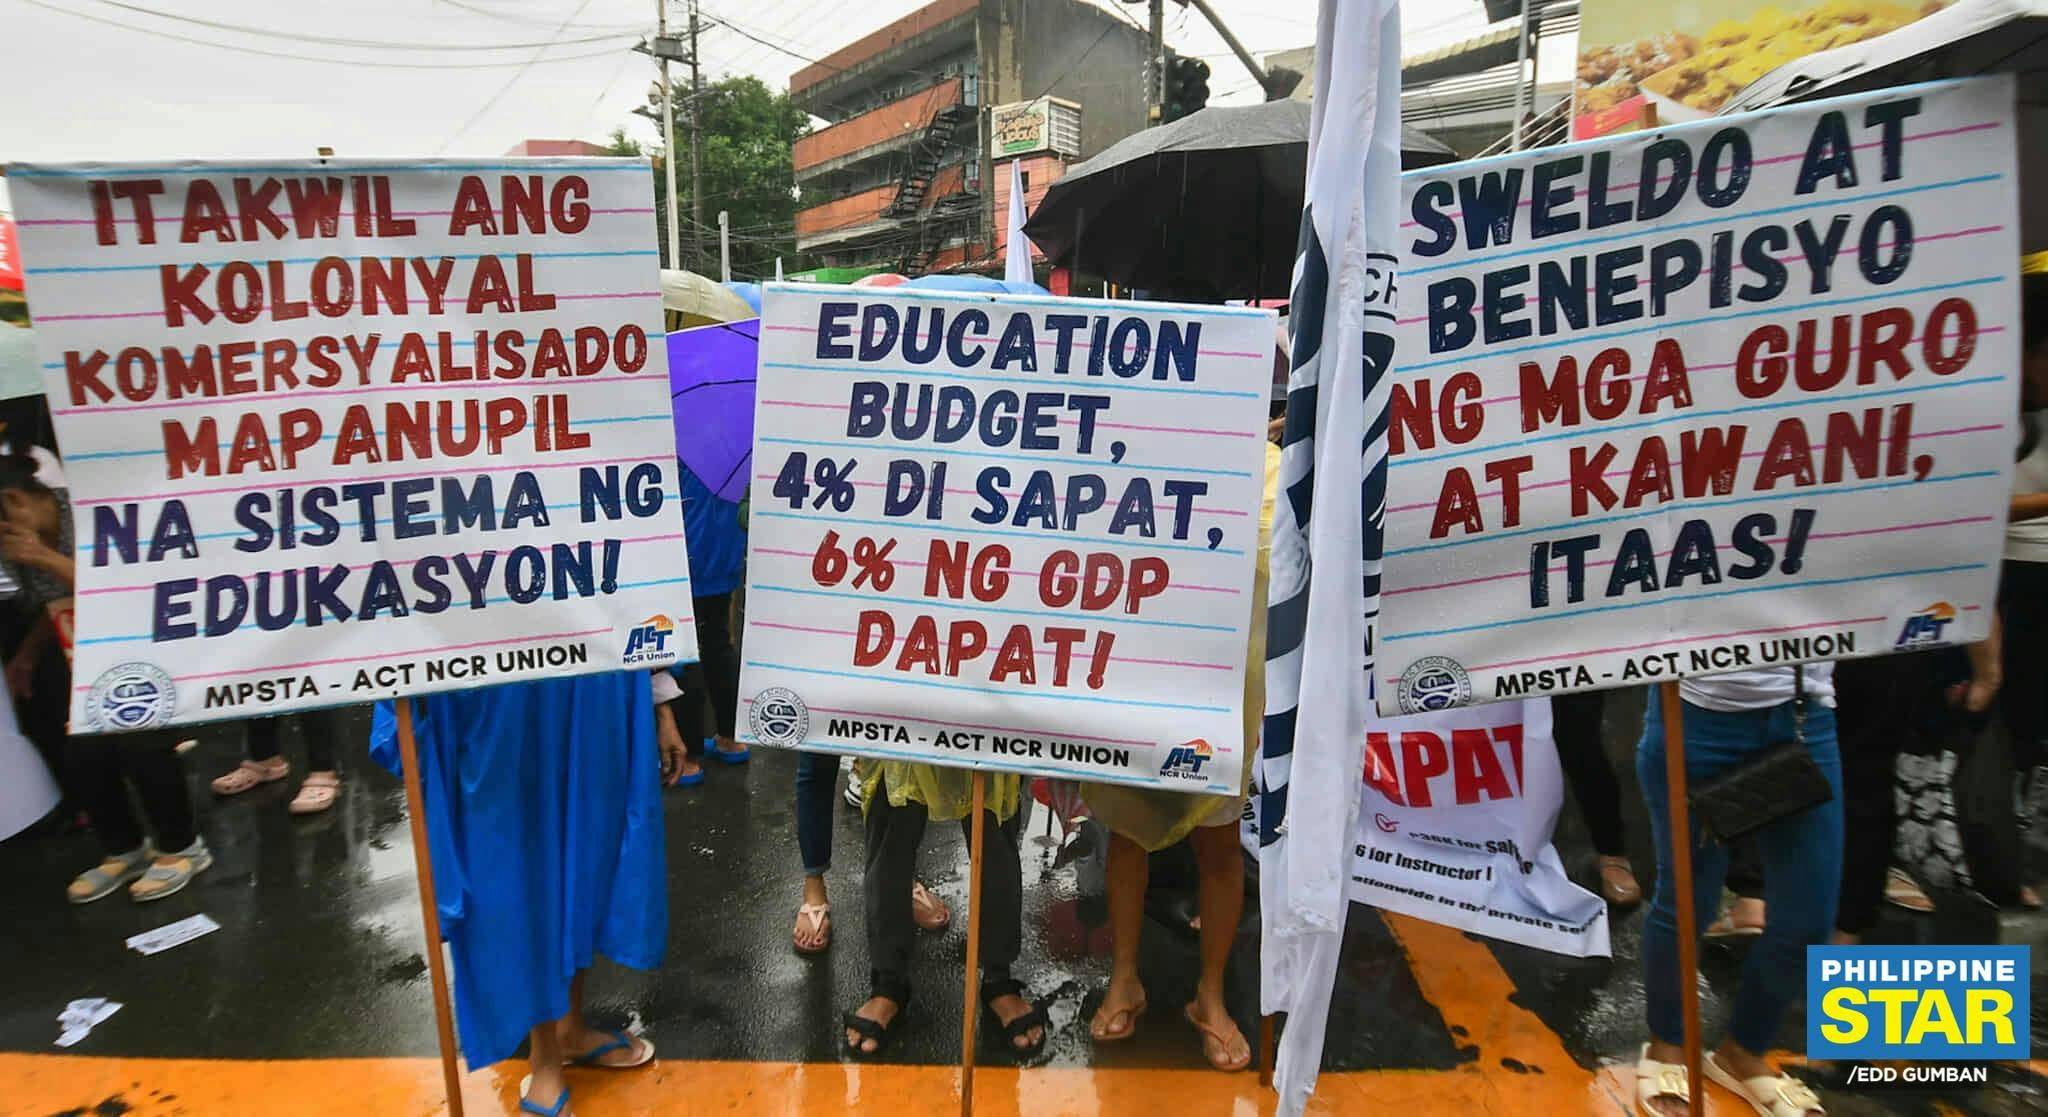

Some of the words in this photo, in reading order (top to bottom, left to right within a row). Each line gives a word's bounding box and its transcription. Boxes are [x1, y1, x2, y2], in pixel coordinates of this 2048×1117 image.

[88, 176, 417, 246] ITAKWIL
[448, 175, 591, 236] ANG
[1411, 127, 1753, 257] SWELDO
[1794, 99, 1921, 195] AT
[160, 253, 557, 327] KOLONYAL
[1428, 204, 1914, 354] BENEPISYO
[63, 323, 648, 406] KOMERSYALISADO
[815, 302, 1201, 382] EDUCATION
[1389, 371, 1485, 455] NG
[1519, 337, 1694, 433] MGA
[1735, 297, 1979, 399] GURO
[161, 394, 592, 480] MAPANUPIL
[846, 381, 1127, 463] BUDGET,
[772, 451, 857, 513] 4%
[884, 459, 946, 520] DI
[970, 466, 1223, 550] SAPAT,
[1429, 454, 1534, 539] AT
[1569, 403, 1935, 518] KAWANI,
[92, 500, 200, 567] NA
[233, 471, 550, 553] SISTEMA
[579, 463, 664, 522] NG
[153, 539, 621, 642] EDUKASYON!
[811, 529, 898, 593] 6%
[924, 539, 1011, 602] NG
[1038, 551, 1170, 615] GDP
[1528, 508, 1816, 608] ITAAS!
[204, 674, 319, 709] MPSTA
[351, 662, 415, 692] ACT
[426, 654, 488, 682] NCR
[496, 642, 588, 673] UNION
[853, 609, 1116, 690] DAPAT!
[1495, 664, 1595, 697] MPSTA
[1622, 651, 1681, 681] ACT
[1691, 643, 1752, 672] NCR
[1760, 631, 1855, 663] UNION
[828, 718, 911, 744] MPSTA
[934, 730, 985, 751] ACT
[992, 736, 1043, 758] NCR
[1050, 742, 1130, 767] UNION
[1352, 875, 1435, 901] ationwide
[1438, 895, 1456, 907] in
[1488, 908, 1553, 929] private
[1369, 847, 1393, 864] for
[1395, 853, 1483, 881] Instructor
